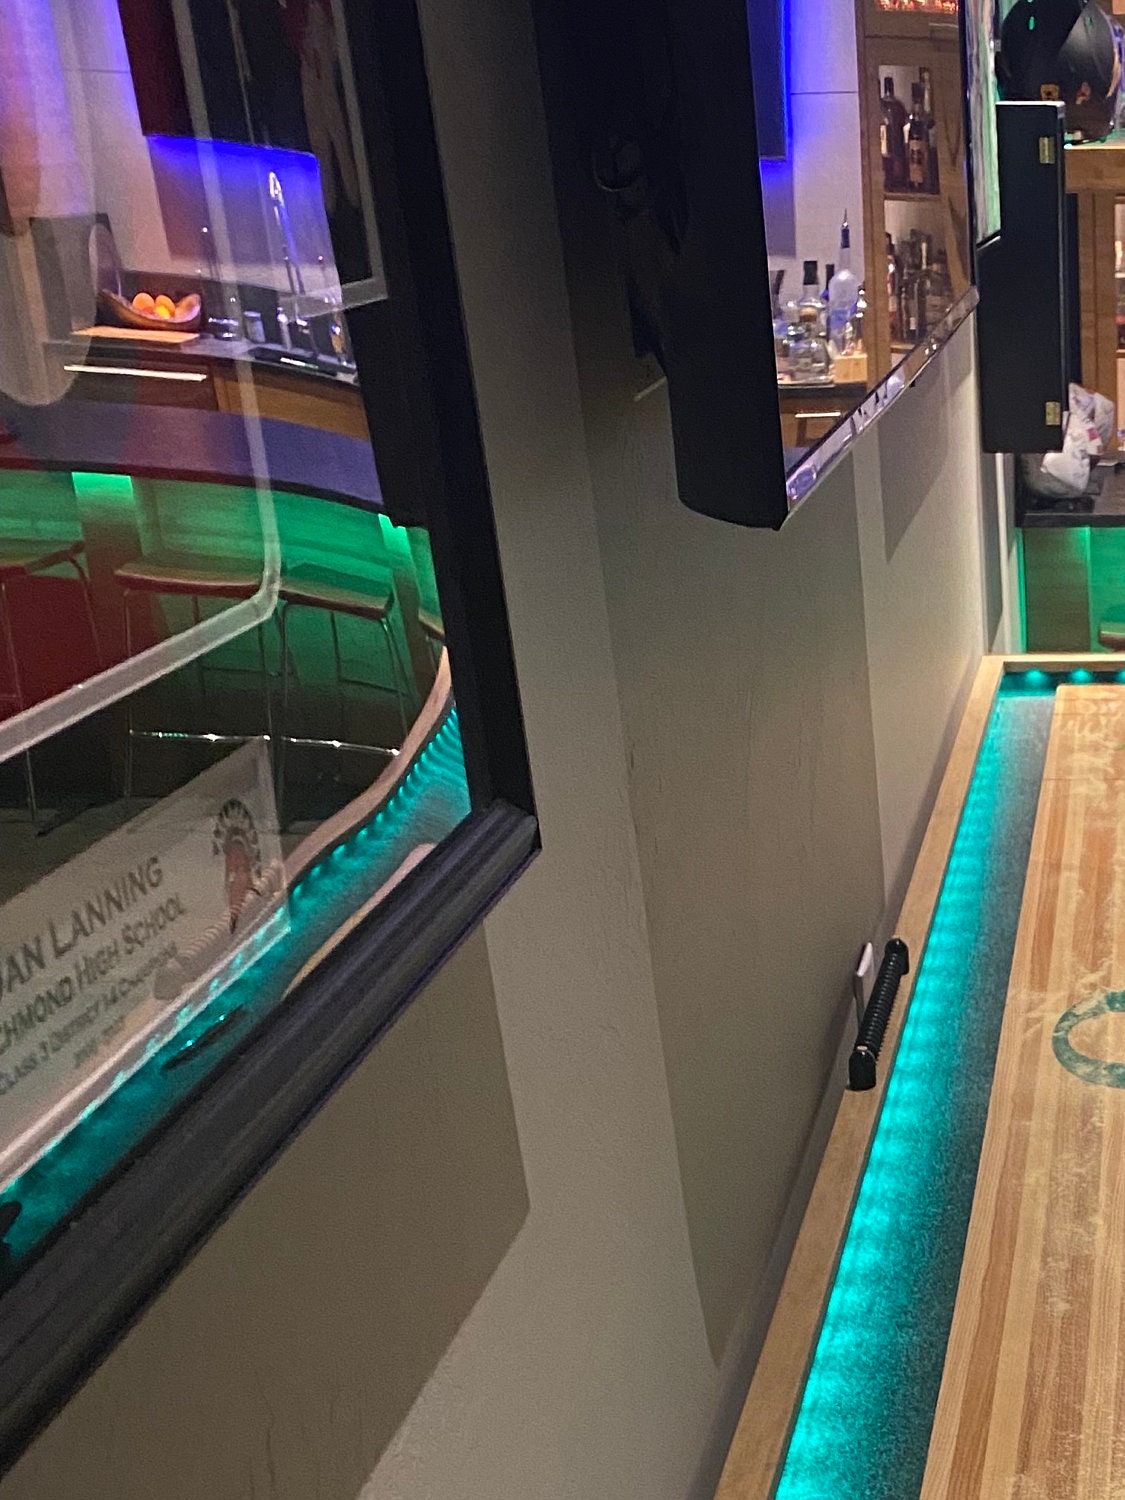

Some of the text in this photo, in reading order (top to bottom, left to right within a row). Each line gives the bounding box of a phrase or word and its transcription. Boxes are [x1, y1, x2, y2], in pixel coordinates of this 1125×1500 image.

[0, 935, 46, 997] AN
[49, 856, 163, 959] LANNING
[74, 939, 120, 991] HIGH
[121, 893, 187, 955] SCHOOL
